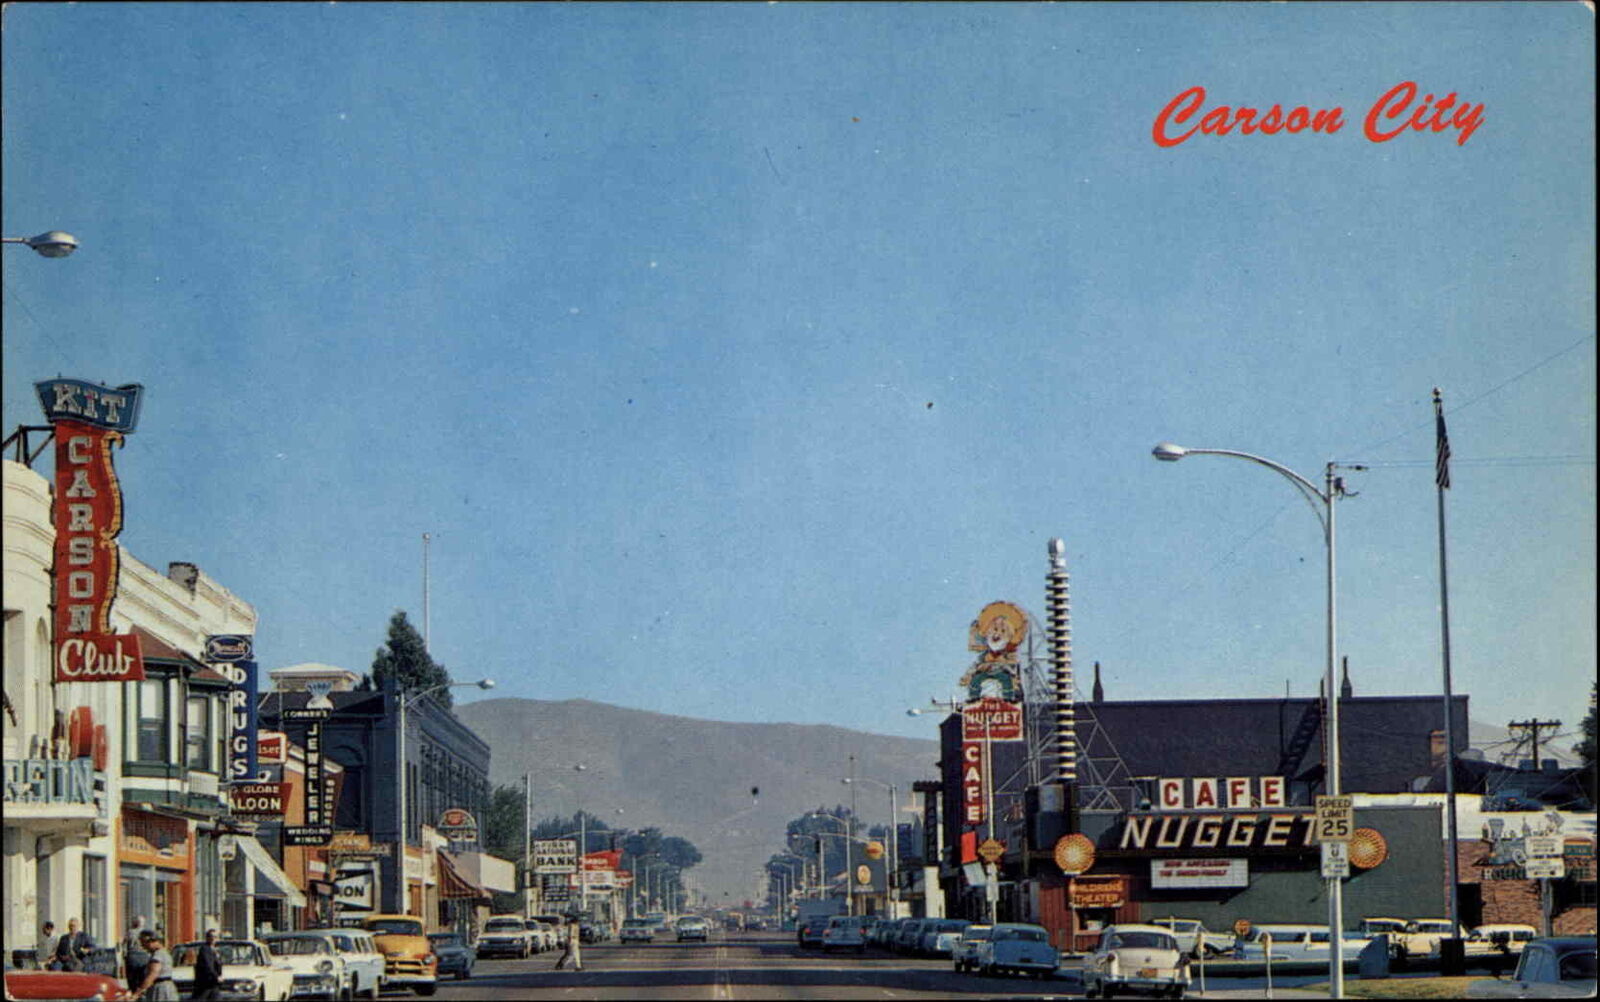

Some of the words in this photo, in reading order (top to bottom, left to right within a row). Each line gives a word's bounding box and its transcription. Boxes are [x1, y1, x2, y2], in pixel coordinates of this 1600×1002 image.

[53, 383, 126, 423] KIT
[66, 435, 96, 634] CARSON
[60, 639, 134, 677] Club
[233, 667, 249, 776] DRUGS
[307, 723, 319, 824] JEWELER
[964, 746, 981, 822] CAFE
[229, 797, 281, 811] ALOON
[1163, 780, 1282, 807] CAFE
[1319, 800, 1350, 808] SPEED
[1322, 809, 1347, 818] LIMIT
[1323, 820, 1348, 836] 25
[1120, 815, 1317, 848] NUGGET
[537, 856, 576, 866] BANK
